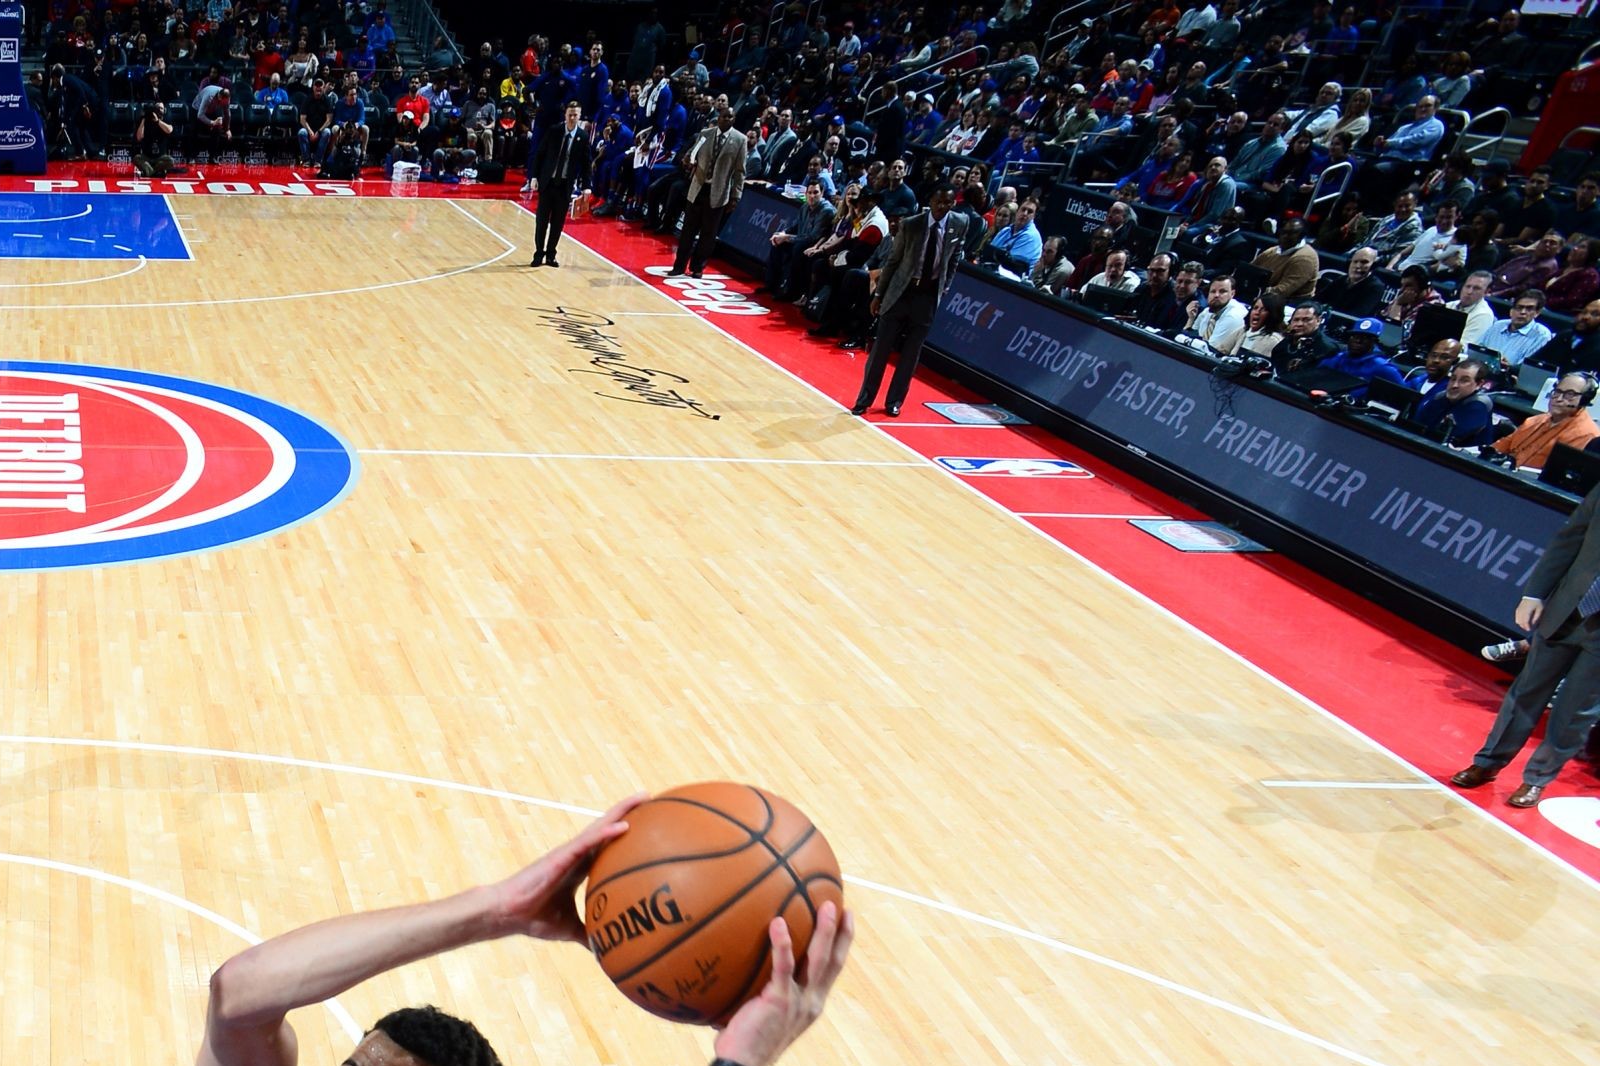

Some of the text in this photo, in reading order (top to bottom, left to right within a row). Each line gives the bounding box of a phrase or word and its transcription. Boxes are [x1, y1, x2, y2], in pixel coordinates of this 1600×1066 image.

[26, 179, 359, 196] PISTONS
[643, 265, 771, 316] Jeep
[1006, 325, 1108, 390] DETROIT'S
[1106, 370, 1196, 440] FASTER,
[1203, 414, 1367, 508] FRIENDLIER
[589, 883, 686, 957] ALDING
